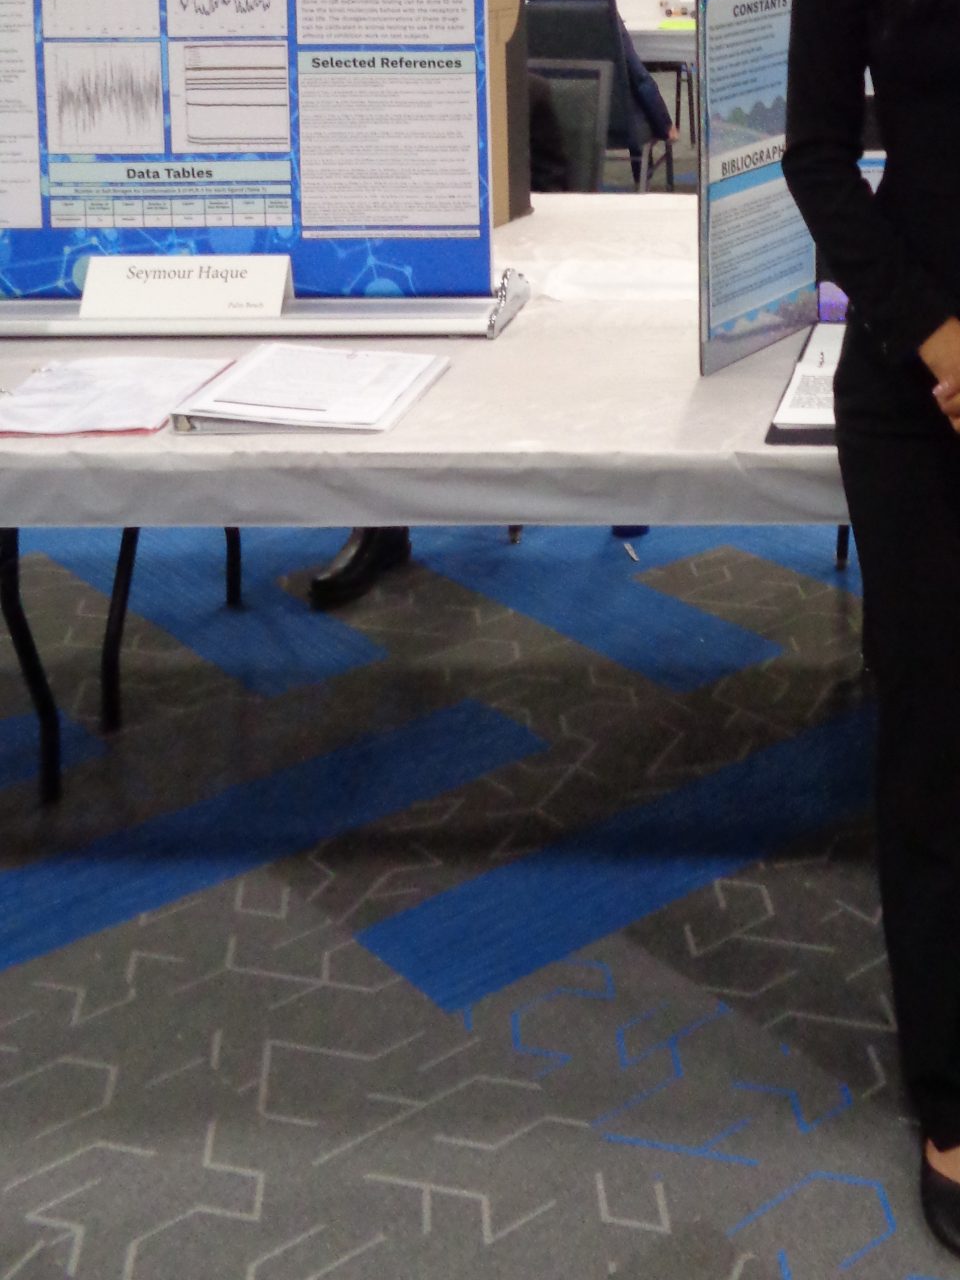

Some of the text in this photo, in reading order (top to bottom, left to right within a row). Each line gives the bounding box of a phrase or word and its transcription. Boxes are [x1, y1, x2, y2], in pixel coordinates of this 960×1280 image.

[311, 57, 462, 69] Selected References
[127, 168, 213, 180] Data Tables
[127, 265, 248, 283] Seymour Haque
